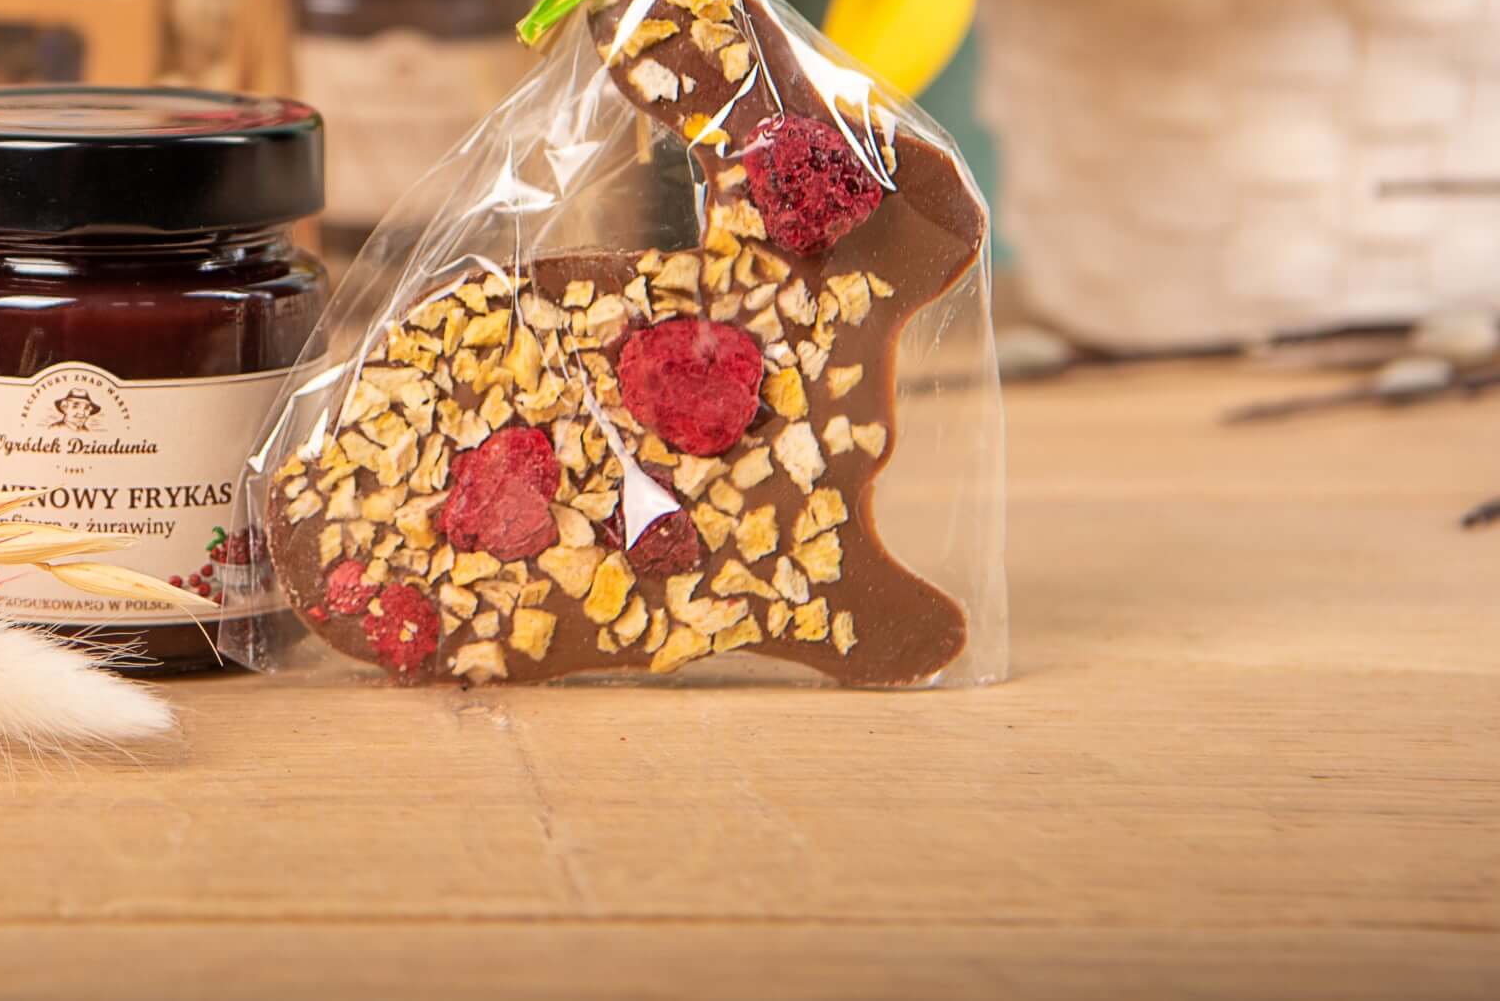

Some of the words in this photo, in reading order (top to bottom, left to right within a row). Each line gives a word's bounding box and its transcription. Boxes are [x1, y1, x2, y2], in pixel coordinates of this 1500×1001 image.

[67, 437, 158, 455] Dziadunia
[128, 482, 233, 509] FRYKAS
[86, 517, 177, 540] żurawiny
